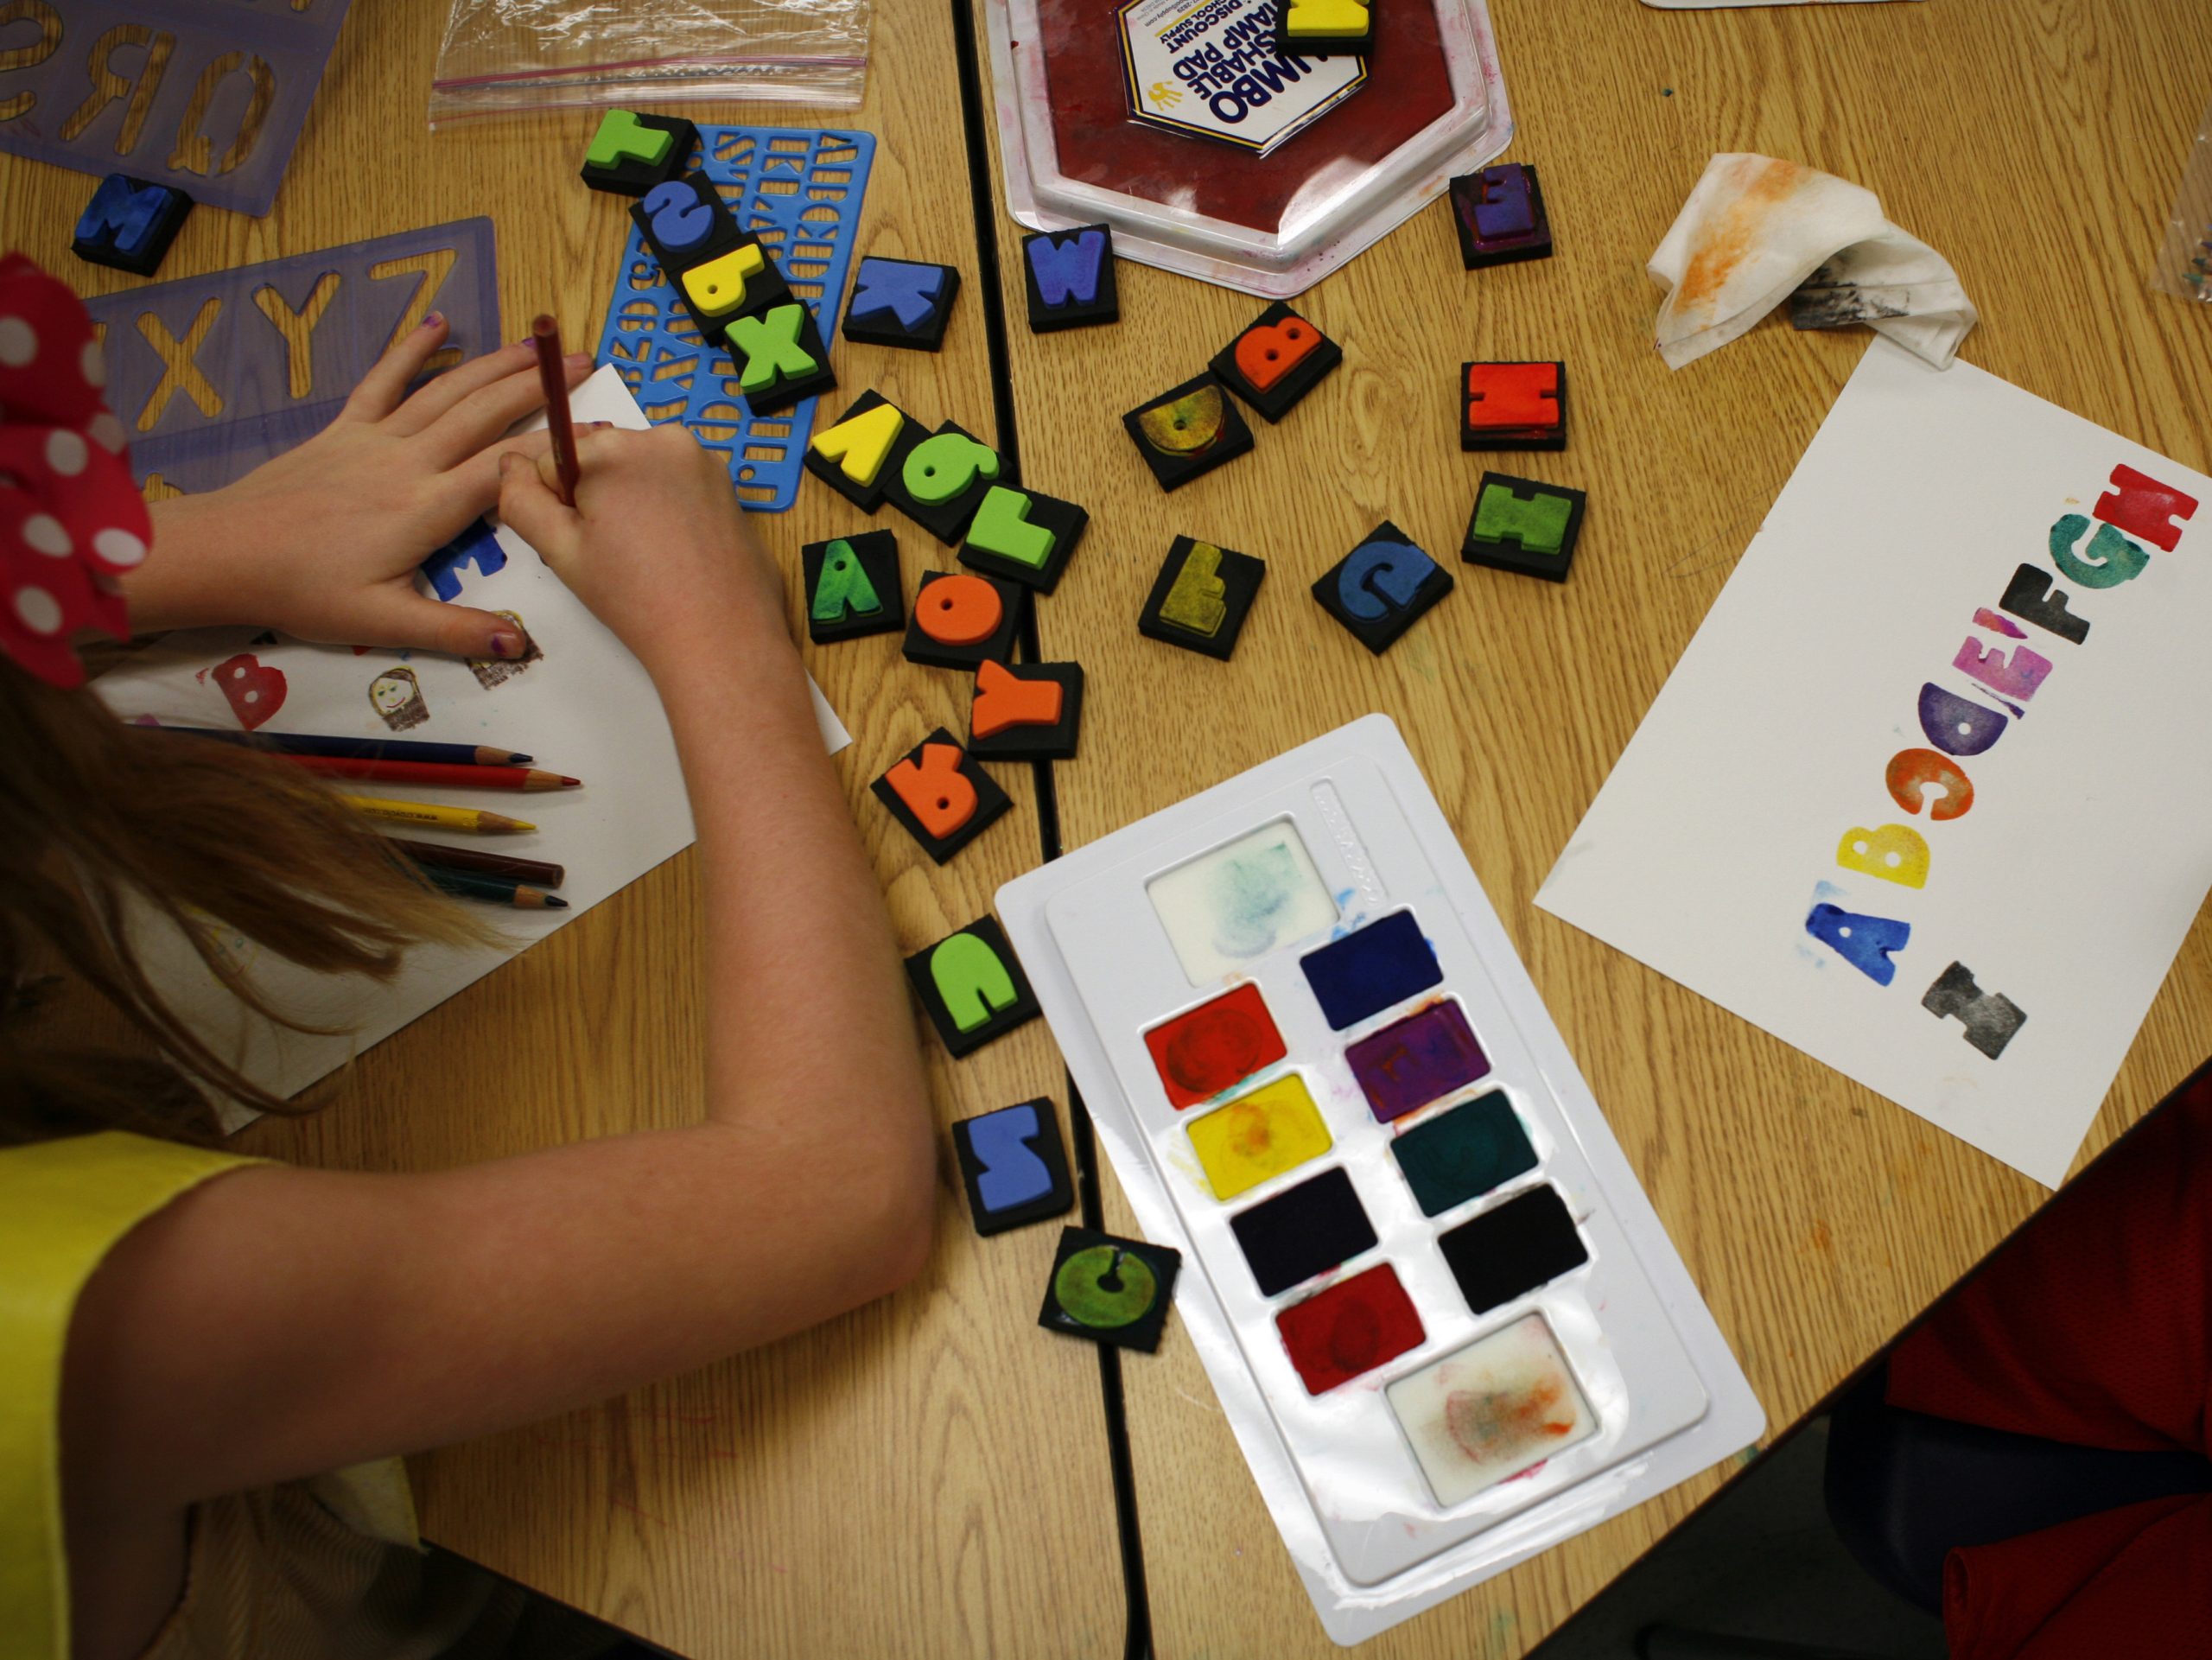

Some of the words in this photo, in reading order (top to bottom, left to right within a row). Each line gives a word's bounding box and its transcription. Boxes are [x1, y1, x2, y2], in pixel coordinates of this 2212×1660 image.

[1160, 18, 1193, 44] SUPPLY
[1166, 0, 1243, 54] DISCOUNT
[1173, 41, 1224, 80] PAD
[1186, 29, 1278, 100] SHABLE
[1027, 230, 1106, 308] W
[724, 303, 819, 392] X
[811, 538, 885, 624] A
[970, 658, 1064, 741] Y
